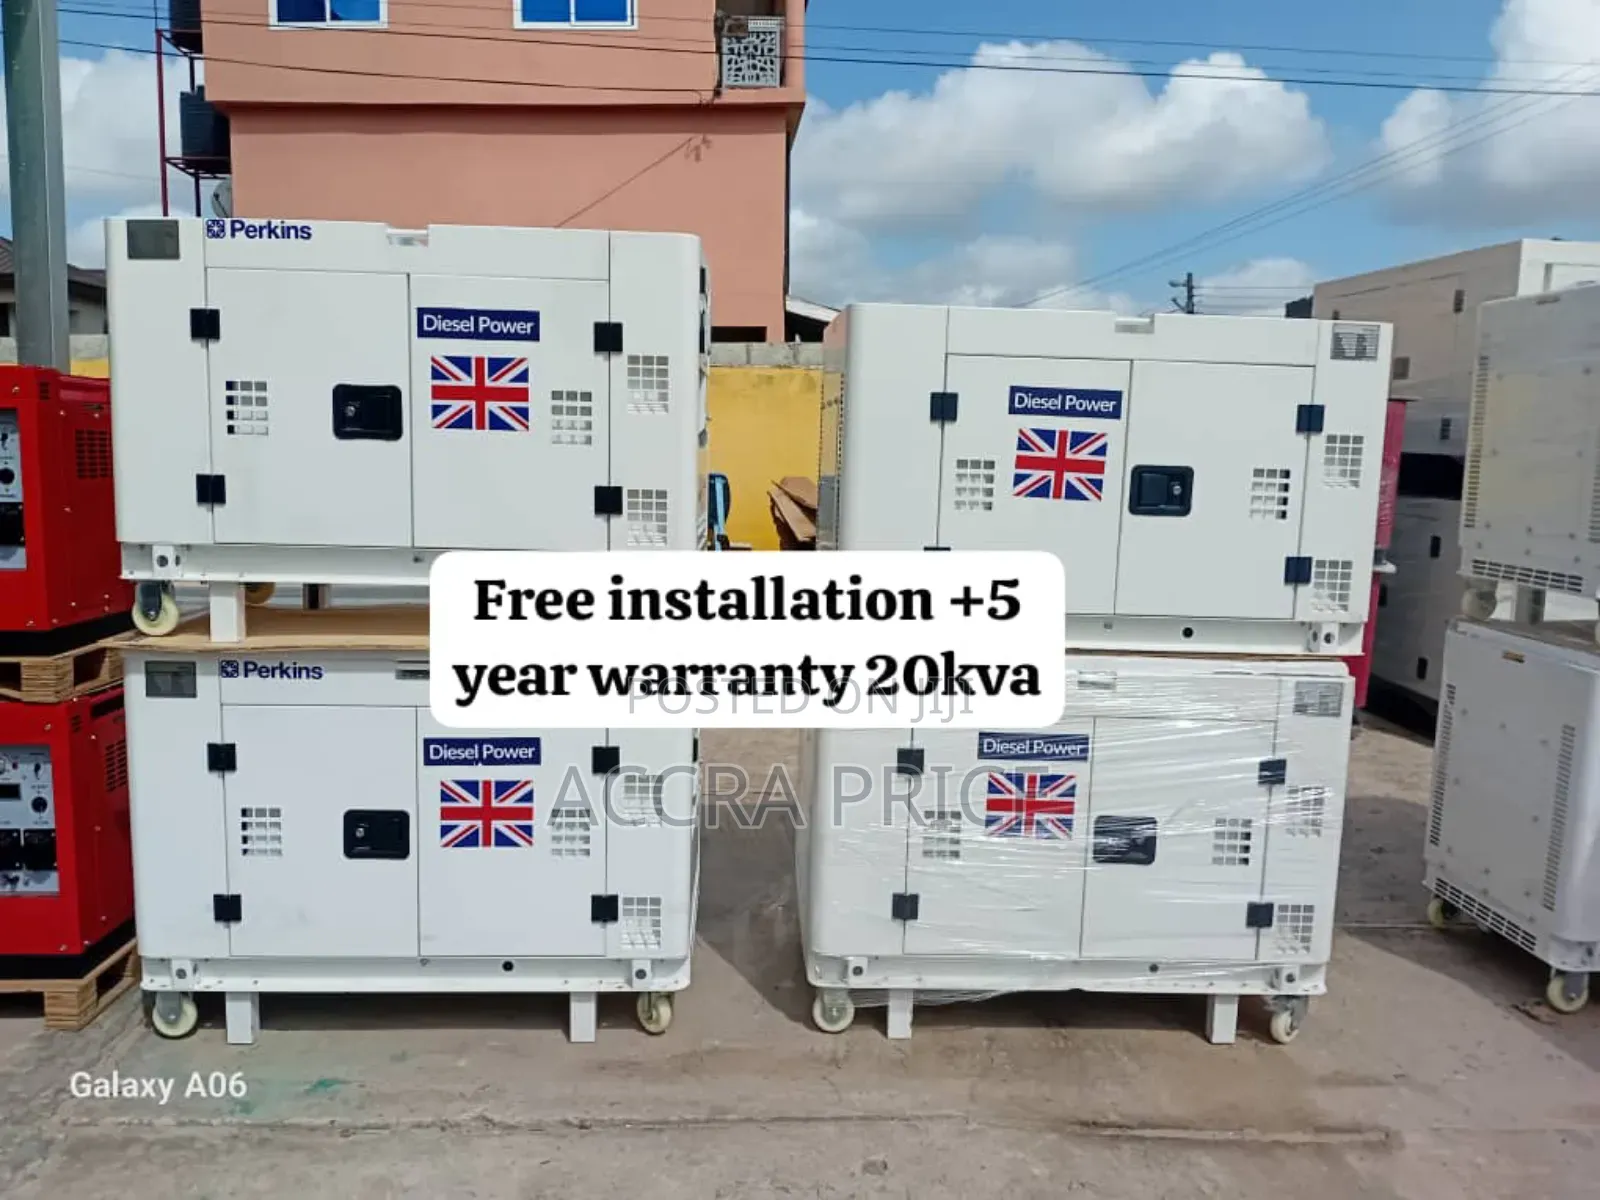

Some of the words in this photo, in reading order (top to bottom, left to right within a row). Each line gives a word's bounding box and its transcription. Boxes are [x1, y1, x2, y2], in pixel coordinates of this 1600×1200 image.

[230, 219, 312, 240] Perkins
[422, 313, 475, 333] Diesel
[478, 315, 536, 335] Power
[1014, 391, 1062, 410] Diesel
[1064, 394, 1117, 412] Power
[243, 660, 323, 680] Perkins
[429, 743, 479, 760] Diesel
[482, 744, 536, 760] Power
[982, 737, 1030, 754] Diesel
[1033, 739, 1082, 757] Power
